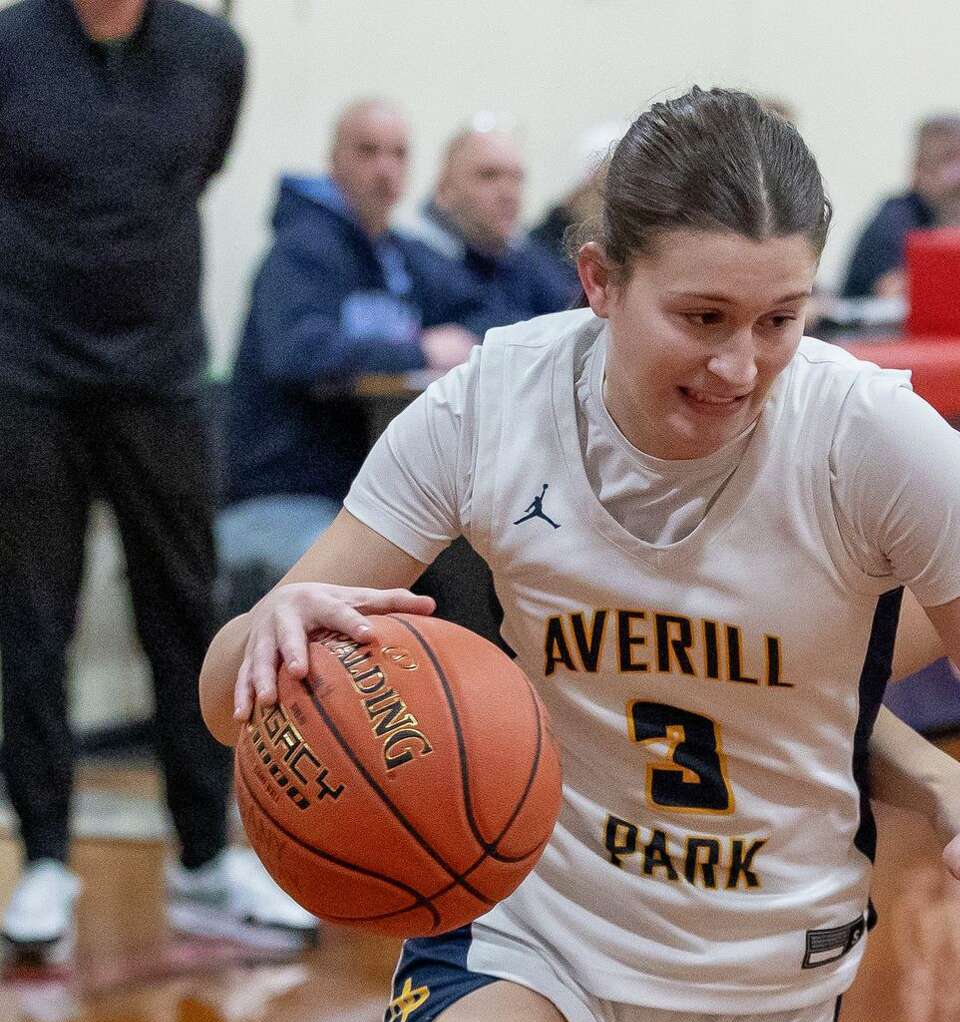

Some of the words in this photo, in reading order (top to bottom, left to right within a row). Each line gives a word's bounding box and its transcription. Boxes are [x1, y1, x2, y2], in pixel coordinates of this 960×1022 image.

[544, 608, 796, 689] AVERILL
[260, 702, 345, 801] GACY
[308, 631, 433, 774] ALDING
[625, 698, 736, 816] 3
[604, 812, 771, 891] PARK
